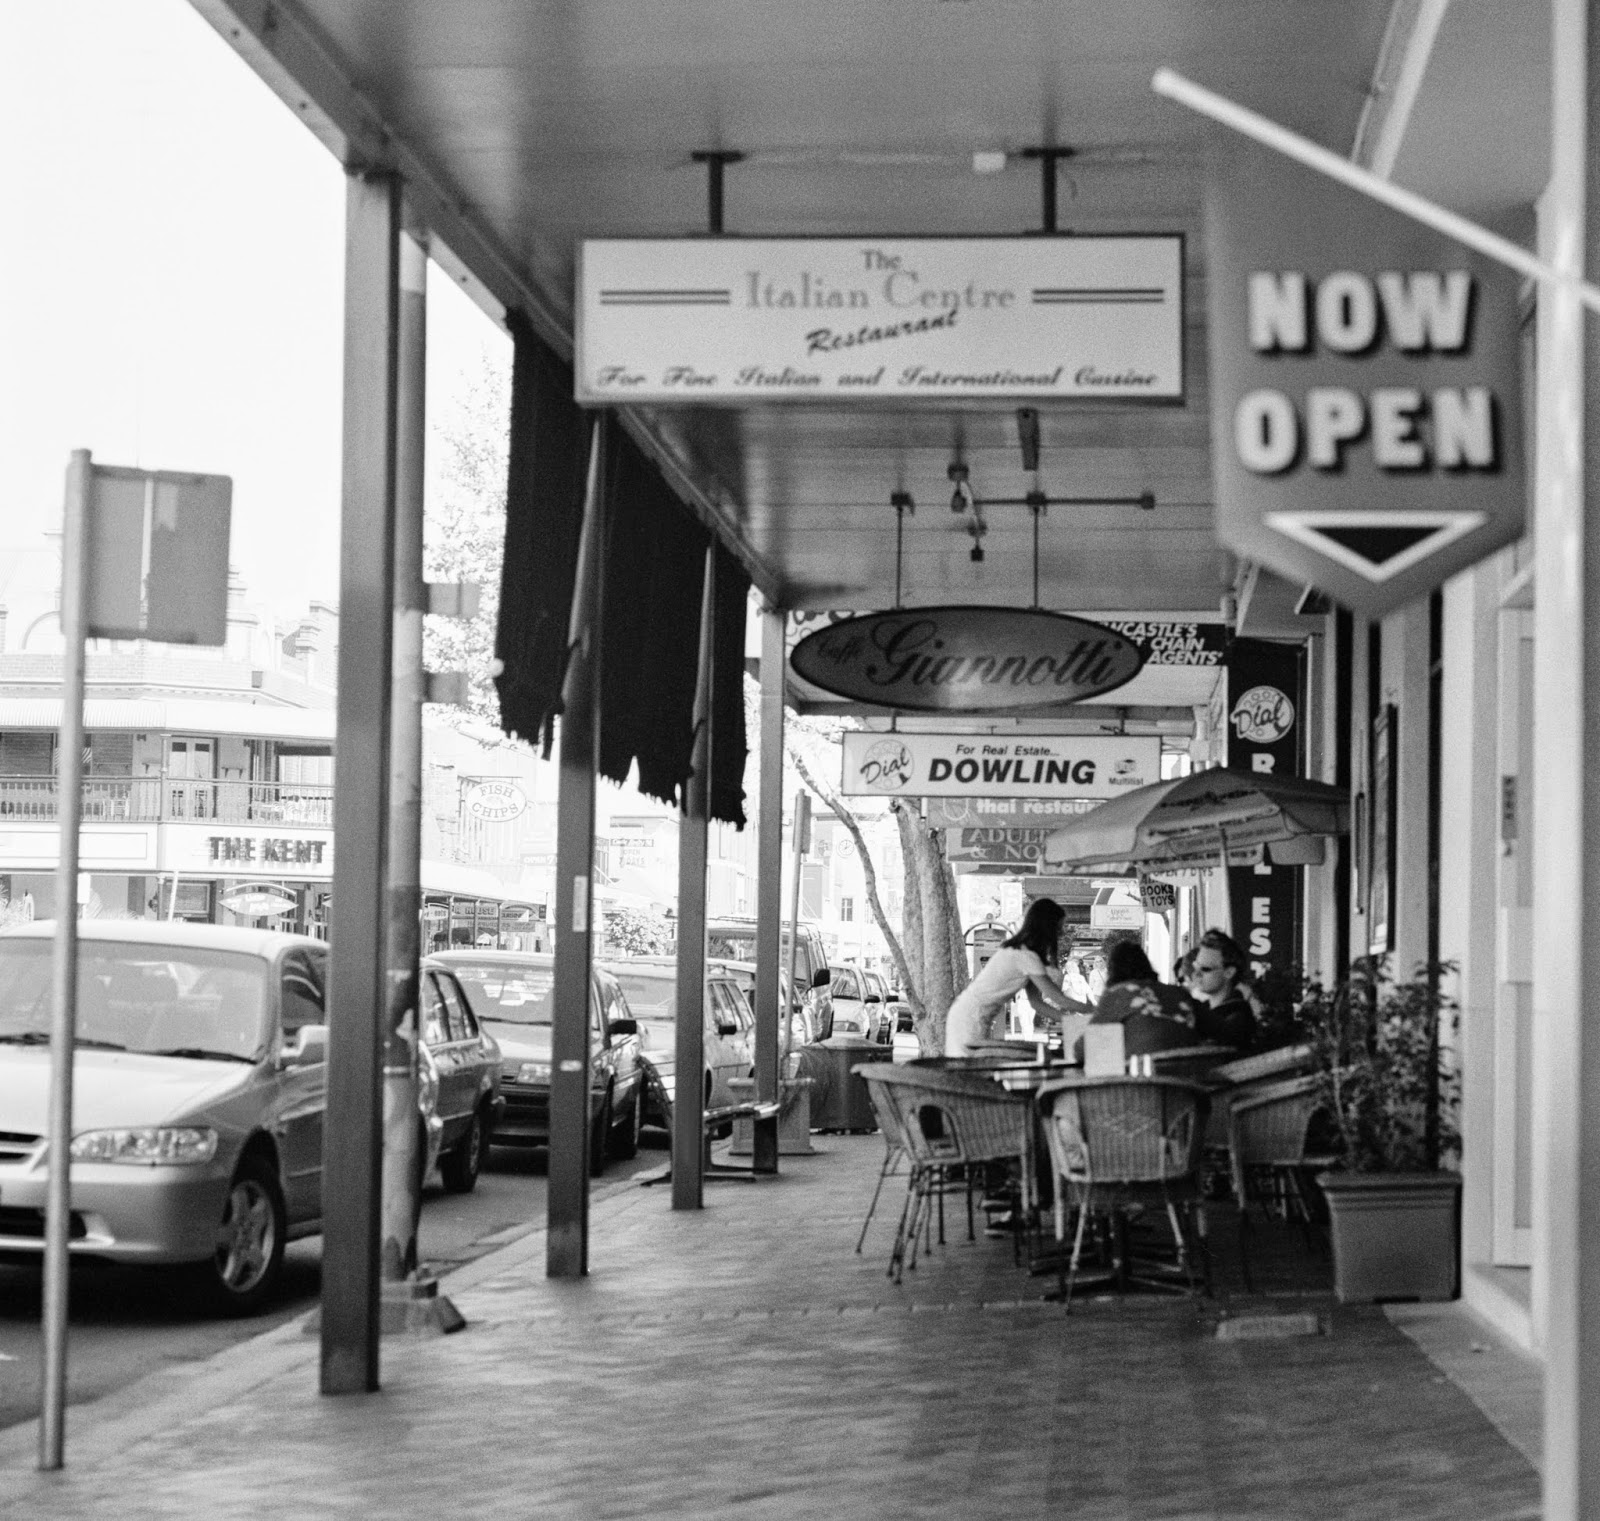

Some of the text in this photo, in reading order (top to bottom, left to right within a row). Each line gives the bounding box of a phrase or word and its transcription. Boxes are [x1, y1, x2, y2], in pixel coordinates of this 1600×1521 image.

[861, 249, 901, 271] The
[746, 270, 1016, 310] Italian Centre
[1250, 270, 1474, 353] NOW
[806, 310, 959, 355] Restaurant
[596, 365, 1158, 387] For Fine Italian and International Cuisine
[1235, 387, 1495, 474] OPEN
[866, 619, 1124, 687] Giannotti
[1150, 637, 1204, 650] CHAIN
[1234, 692, 1283, 737] Dial
[956, 744, 976, 754] For
[982, 745, 1008, 755] Real
[860, 747, 911, 785] Dial
[928, 758, 1097, 785] DOWLING
[479, 784, 515, 798] FISH
[472, 802, 519, 818] CHIPS
[976, 800, 1017, 814] thai
[208, 836, 327, 864] THE KENT
[1140, 885, 1174, 897] BOOKS
[1150, 895, 1175, 907] TOYS
